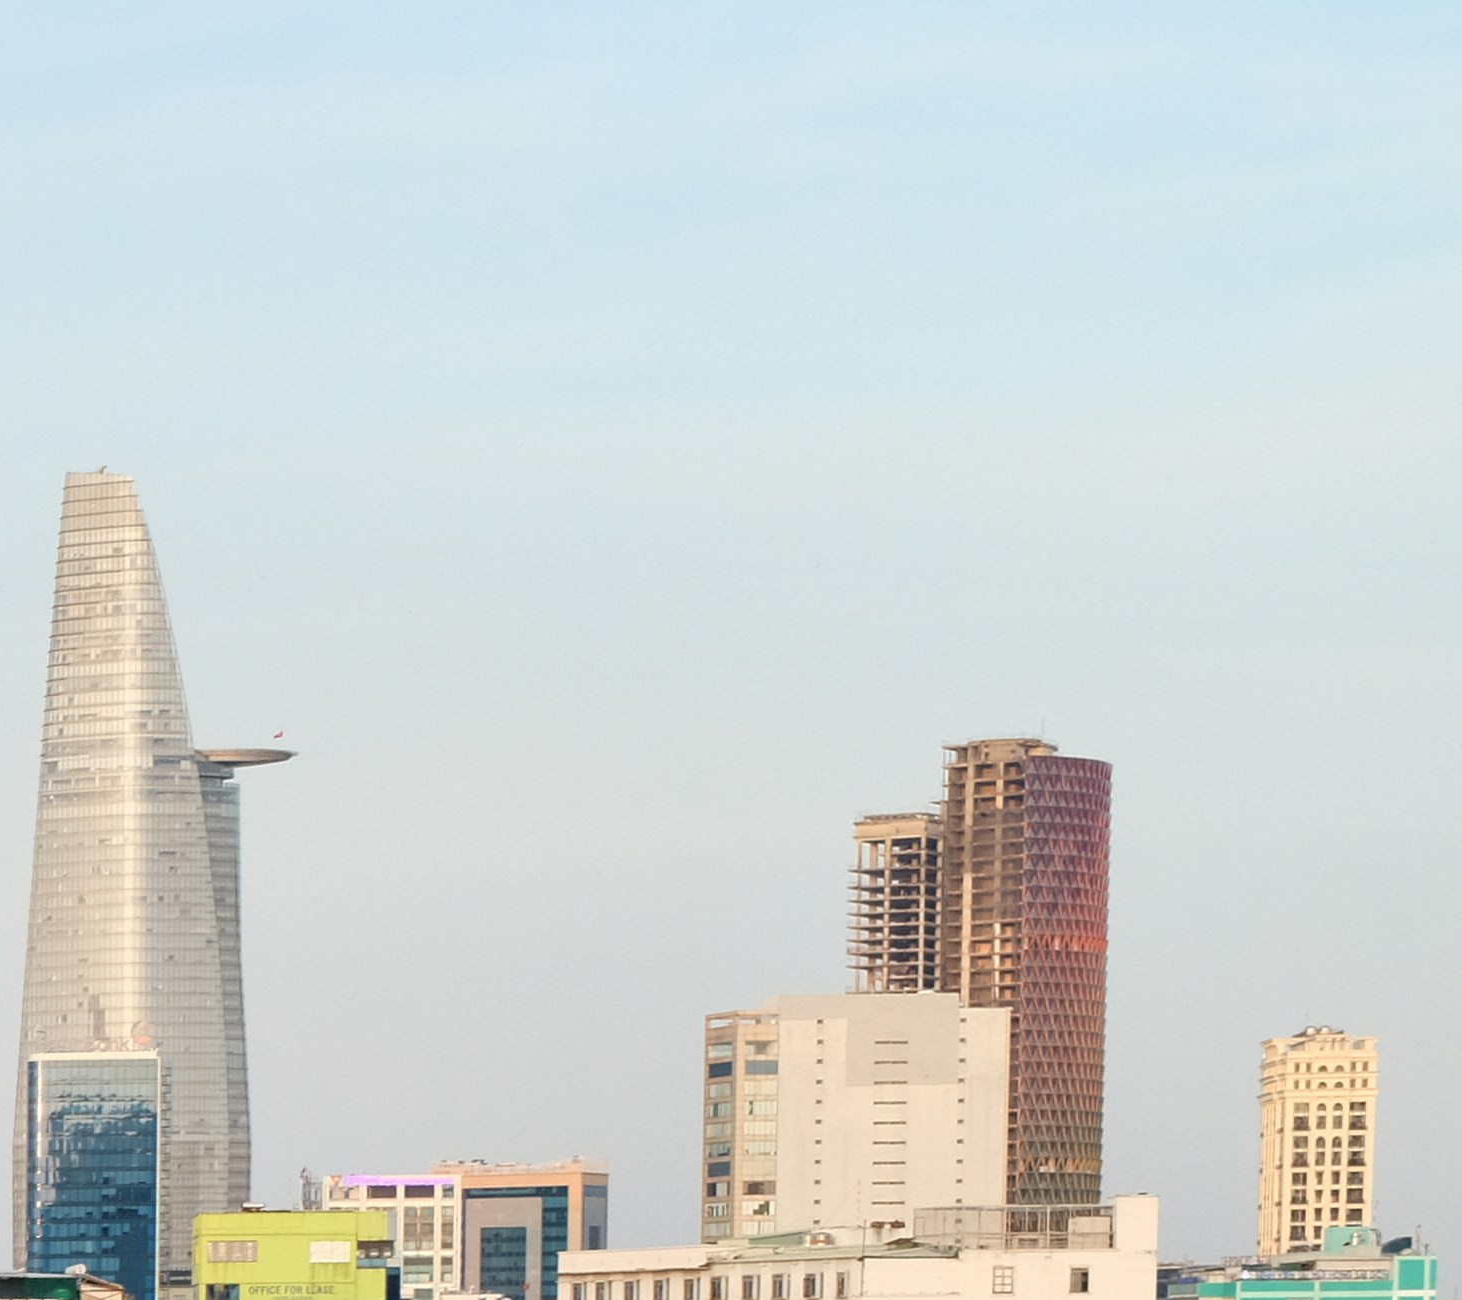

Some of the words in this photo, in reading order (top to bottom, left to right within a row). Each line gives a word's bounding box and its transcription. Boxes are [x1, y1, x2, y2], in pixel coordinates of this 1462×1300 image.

[248, 1285, 282, 1295] OFFICE
[284, 1285, 303, 1294] FOR
[305, 1285, 335, 1295] LEASE
